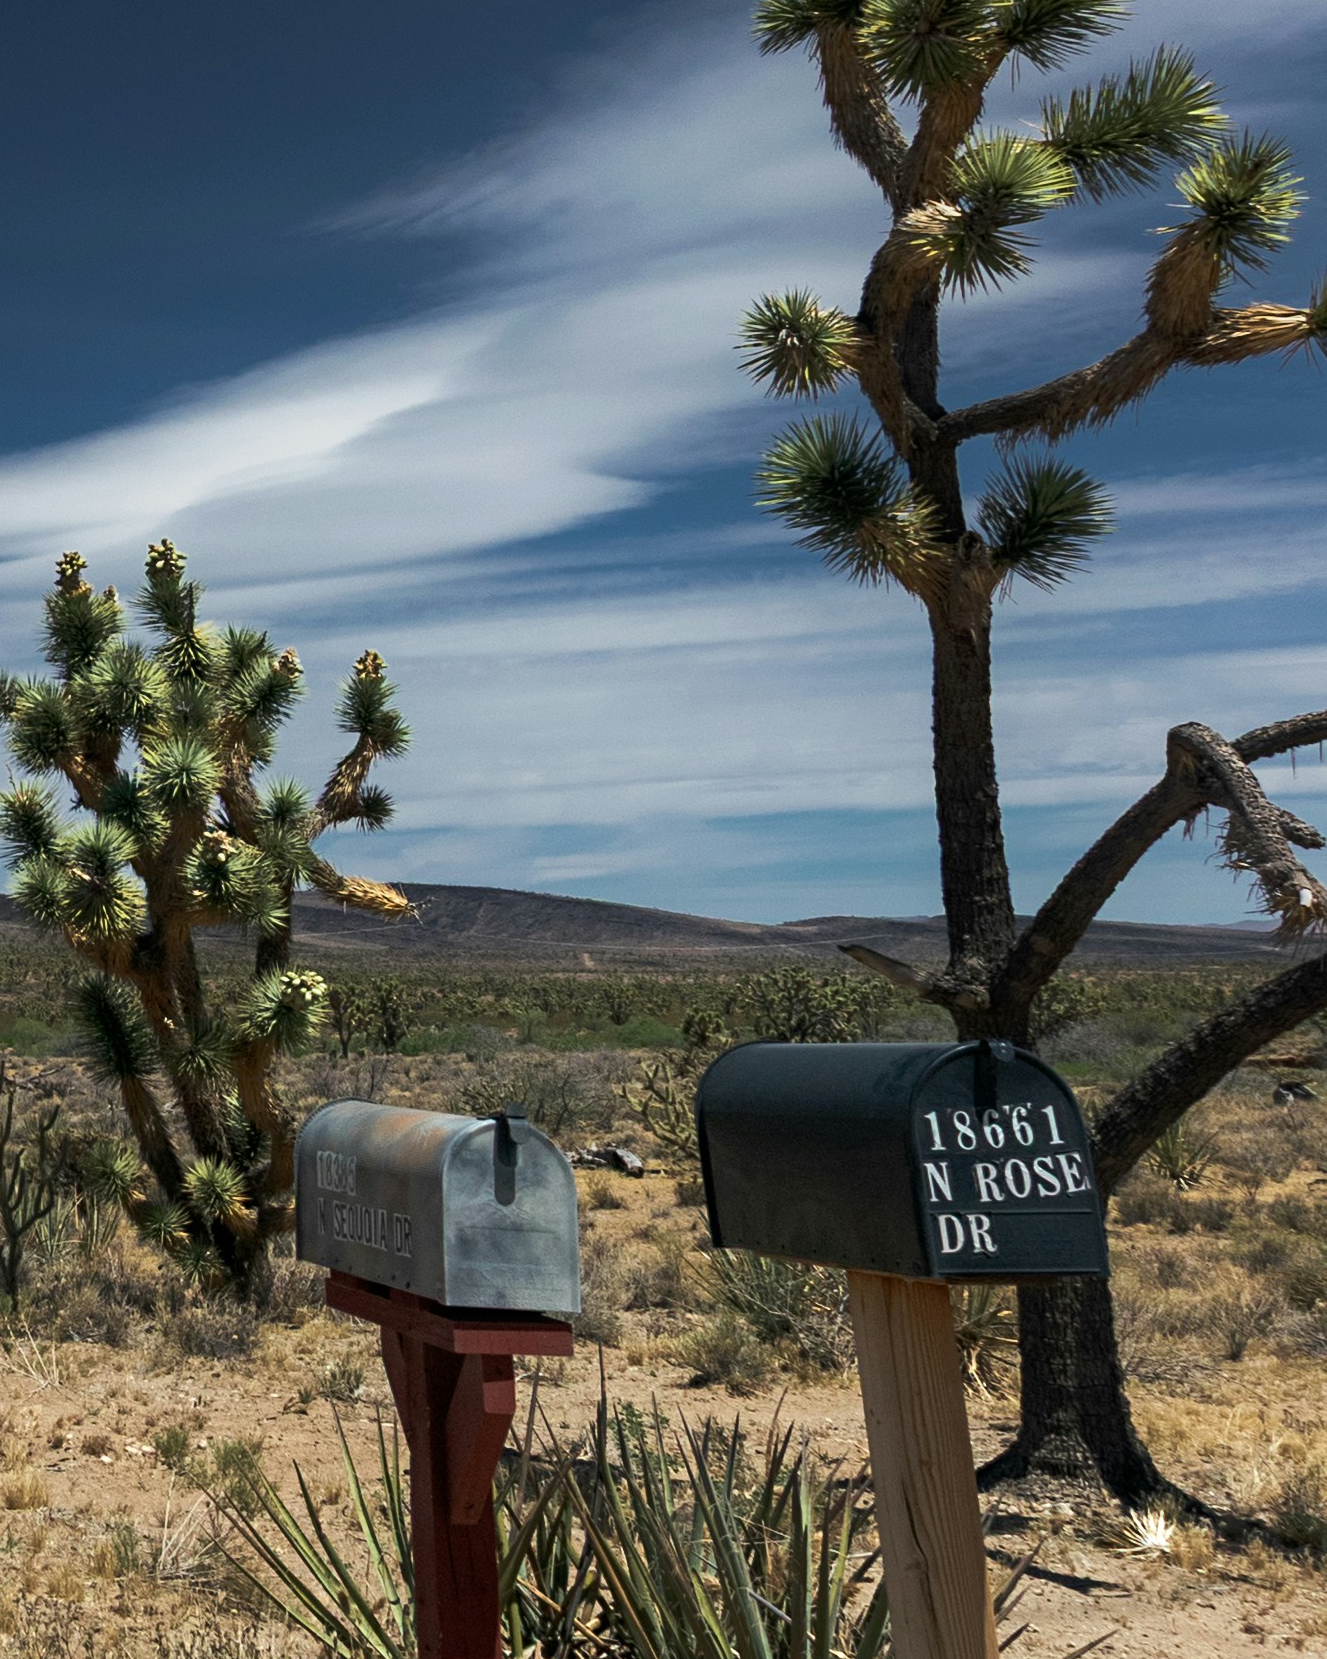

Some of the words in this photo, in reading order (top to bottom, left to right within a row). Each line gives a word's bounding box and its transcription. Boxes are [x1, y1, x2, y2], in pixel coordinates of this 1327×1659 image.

[923, 1102, 1066, 1151] 18661
[923, 1162, 954, 1203] N
[973, 1151, 1092, 1203] ROSE
[317, 1197, 326, 1235] N
[332, 1199, 388, 1253] SEQUOIA
[393, 1212, 412, 1259] DR
[936, 1213, 998, 1255] DR
